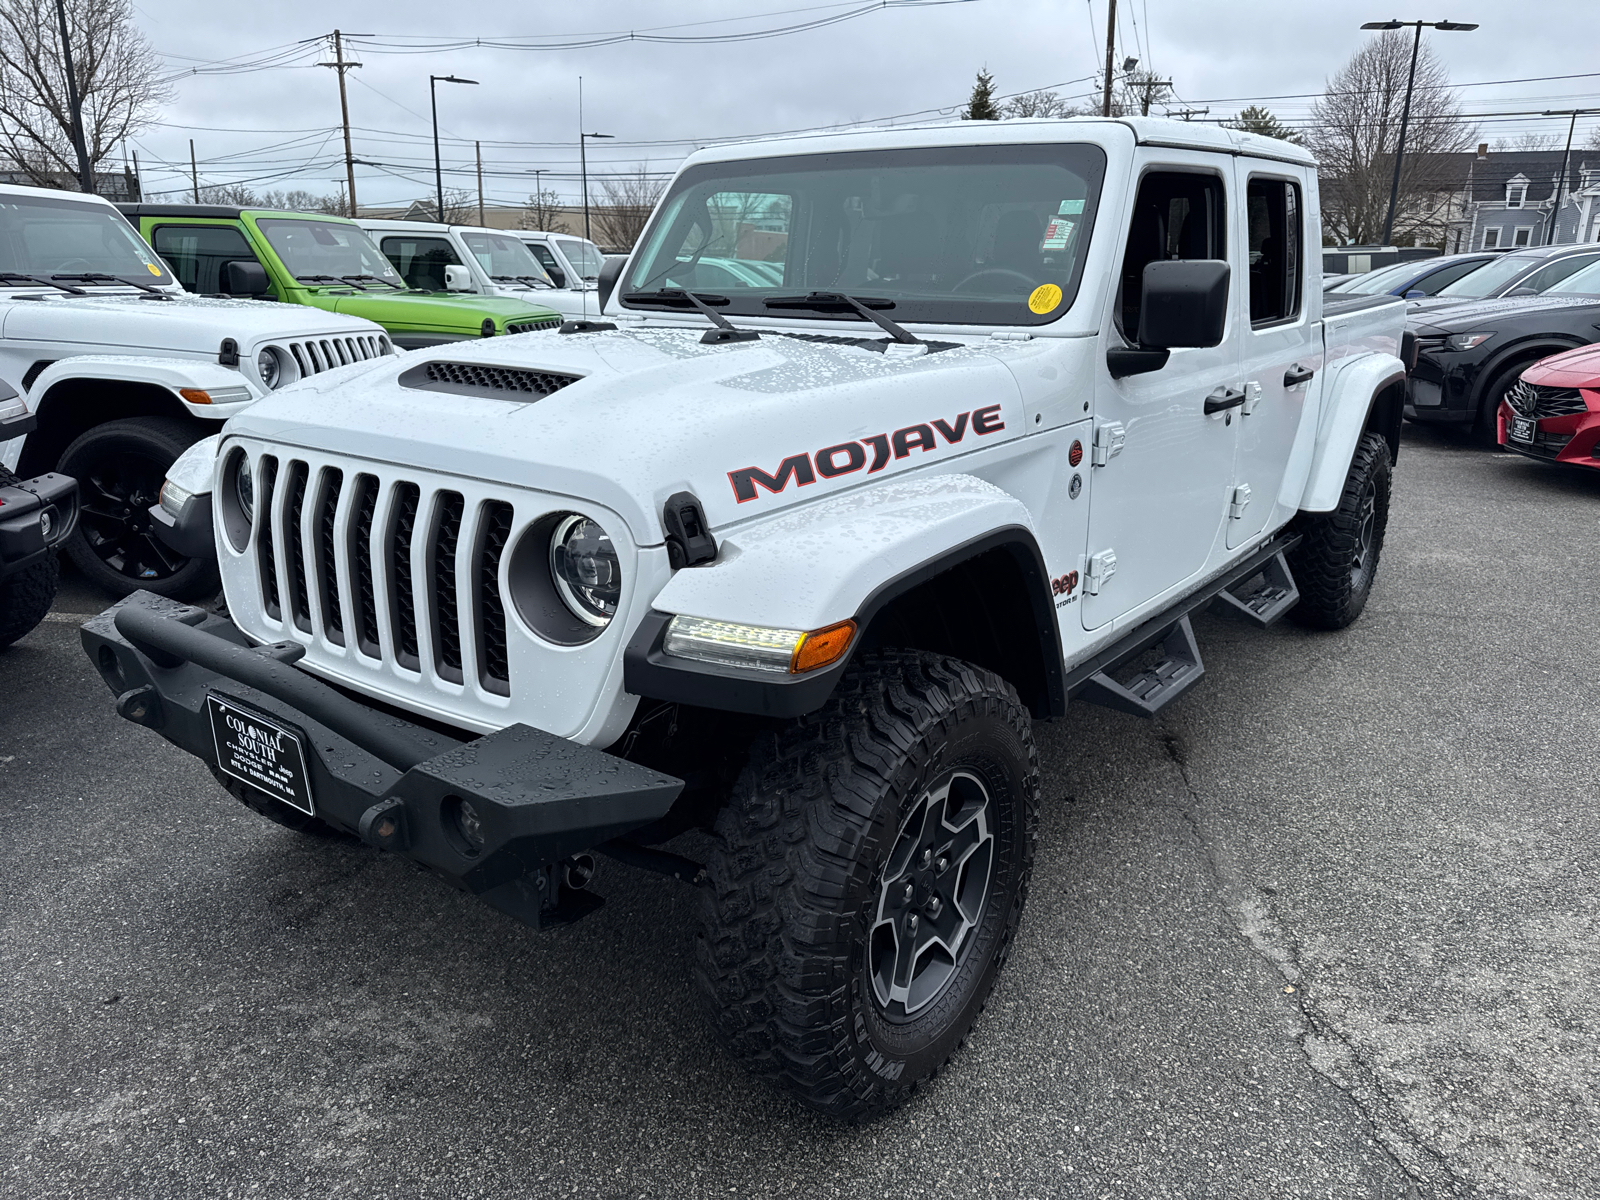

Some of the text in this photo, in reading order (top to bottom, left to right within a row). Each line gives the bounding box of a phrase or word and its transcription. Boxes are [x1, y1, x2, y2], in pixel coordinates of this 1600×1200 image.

[727, 404, 1006, 504] MOJAVE
[1051, 569, 1079, 597] eep
[226, 714, 285, 753] COLONIAL
[226, 741, 274, 768] CHRYSLER
[238, 733, 277, 763] SOUTH
[233, 752, 263, 772] DODGE
[279, 764, 294, 778] Jeep
[268, 769, 289, 784] RAM
